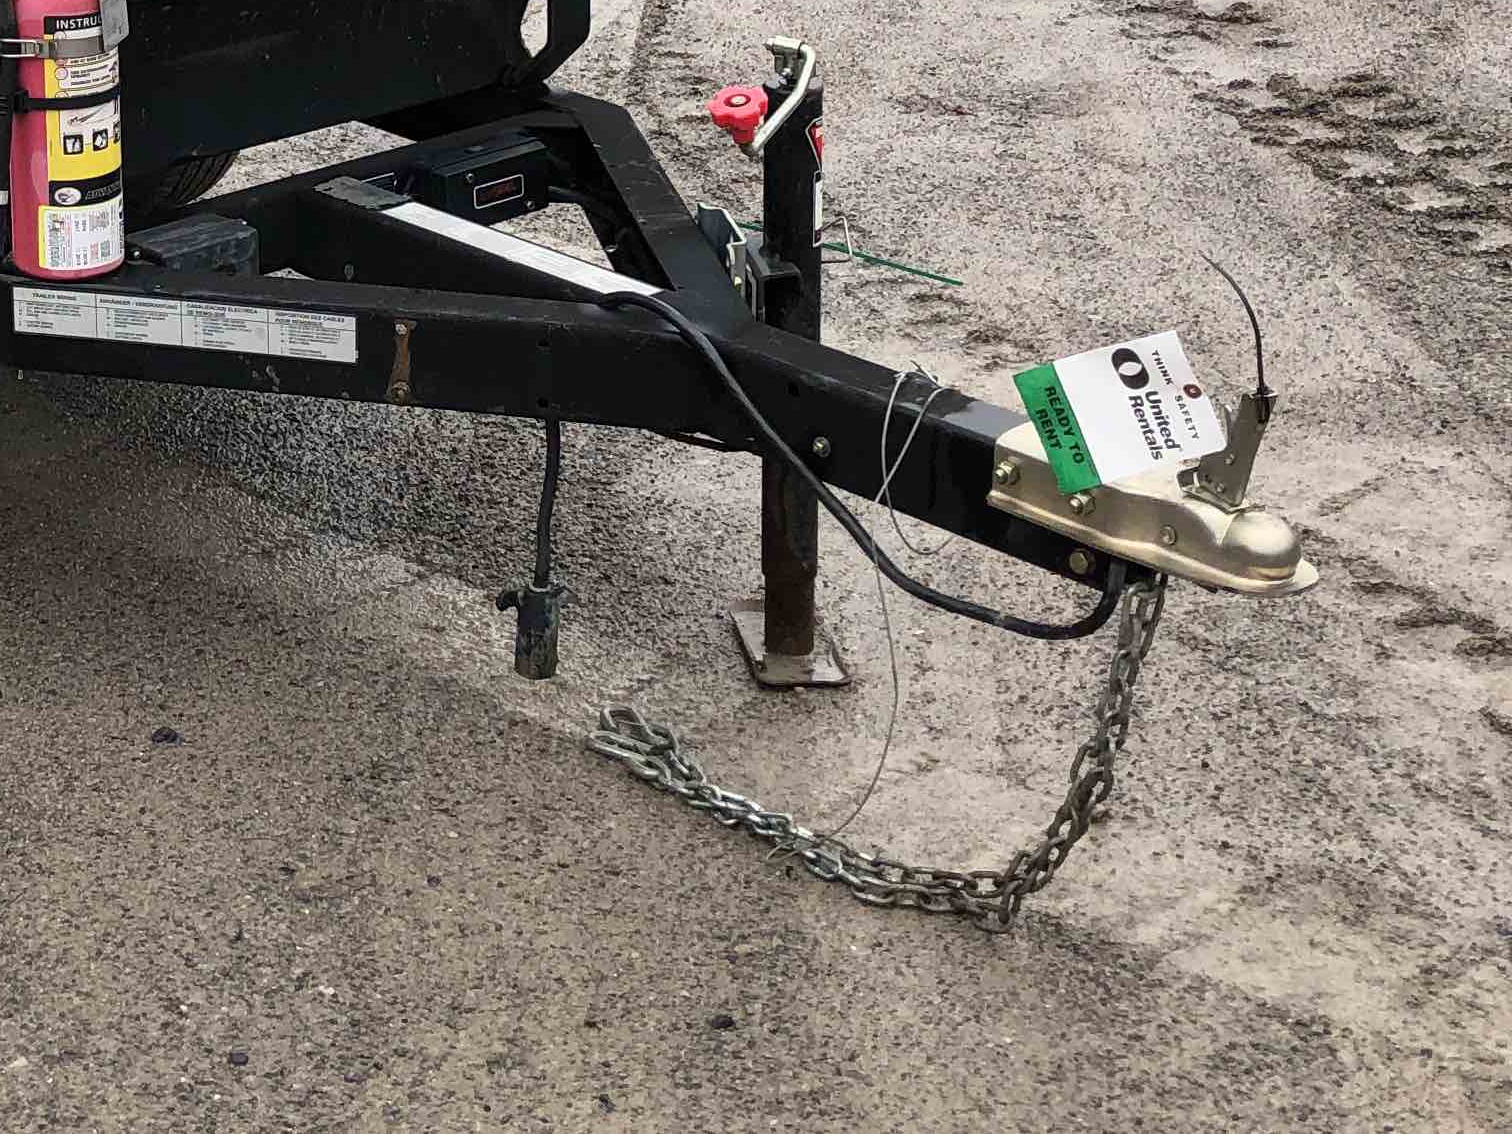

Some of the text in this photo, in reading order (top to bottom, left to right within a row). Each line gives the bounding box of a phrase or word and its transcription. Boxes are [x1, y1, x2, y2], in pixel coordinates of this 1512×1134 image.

[1151, 349, 1174, 386] THINK
[1035, 408, 1061, 451] RENT
[1043, 385, 1085, 464] READY TO
[1128, 395, 1164, 461] Rentals
[1145, 390, 1182, 452] United
[1174, 394, 1200, 440] SAFETY
